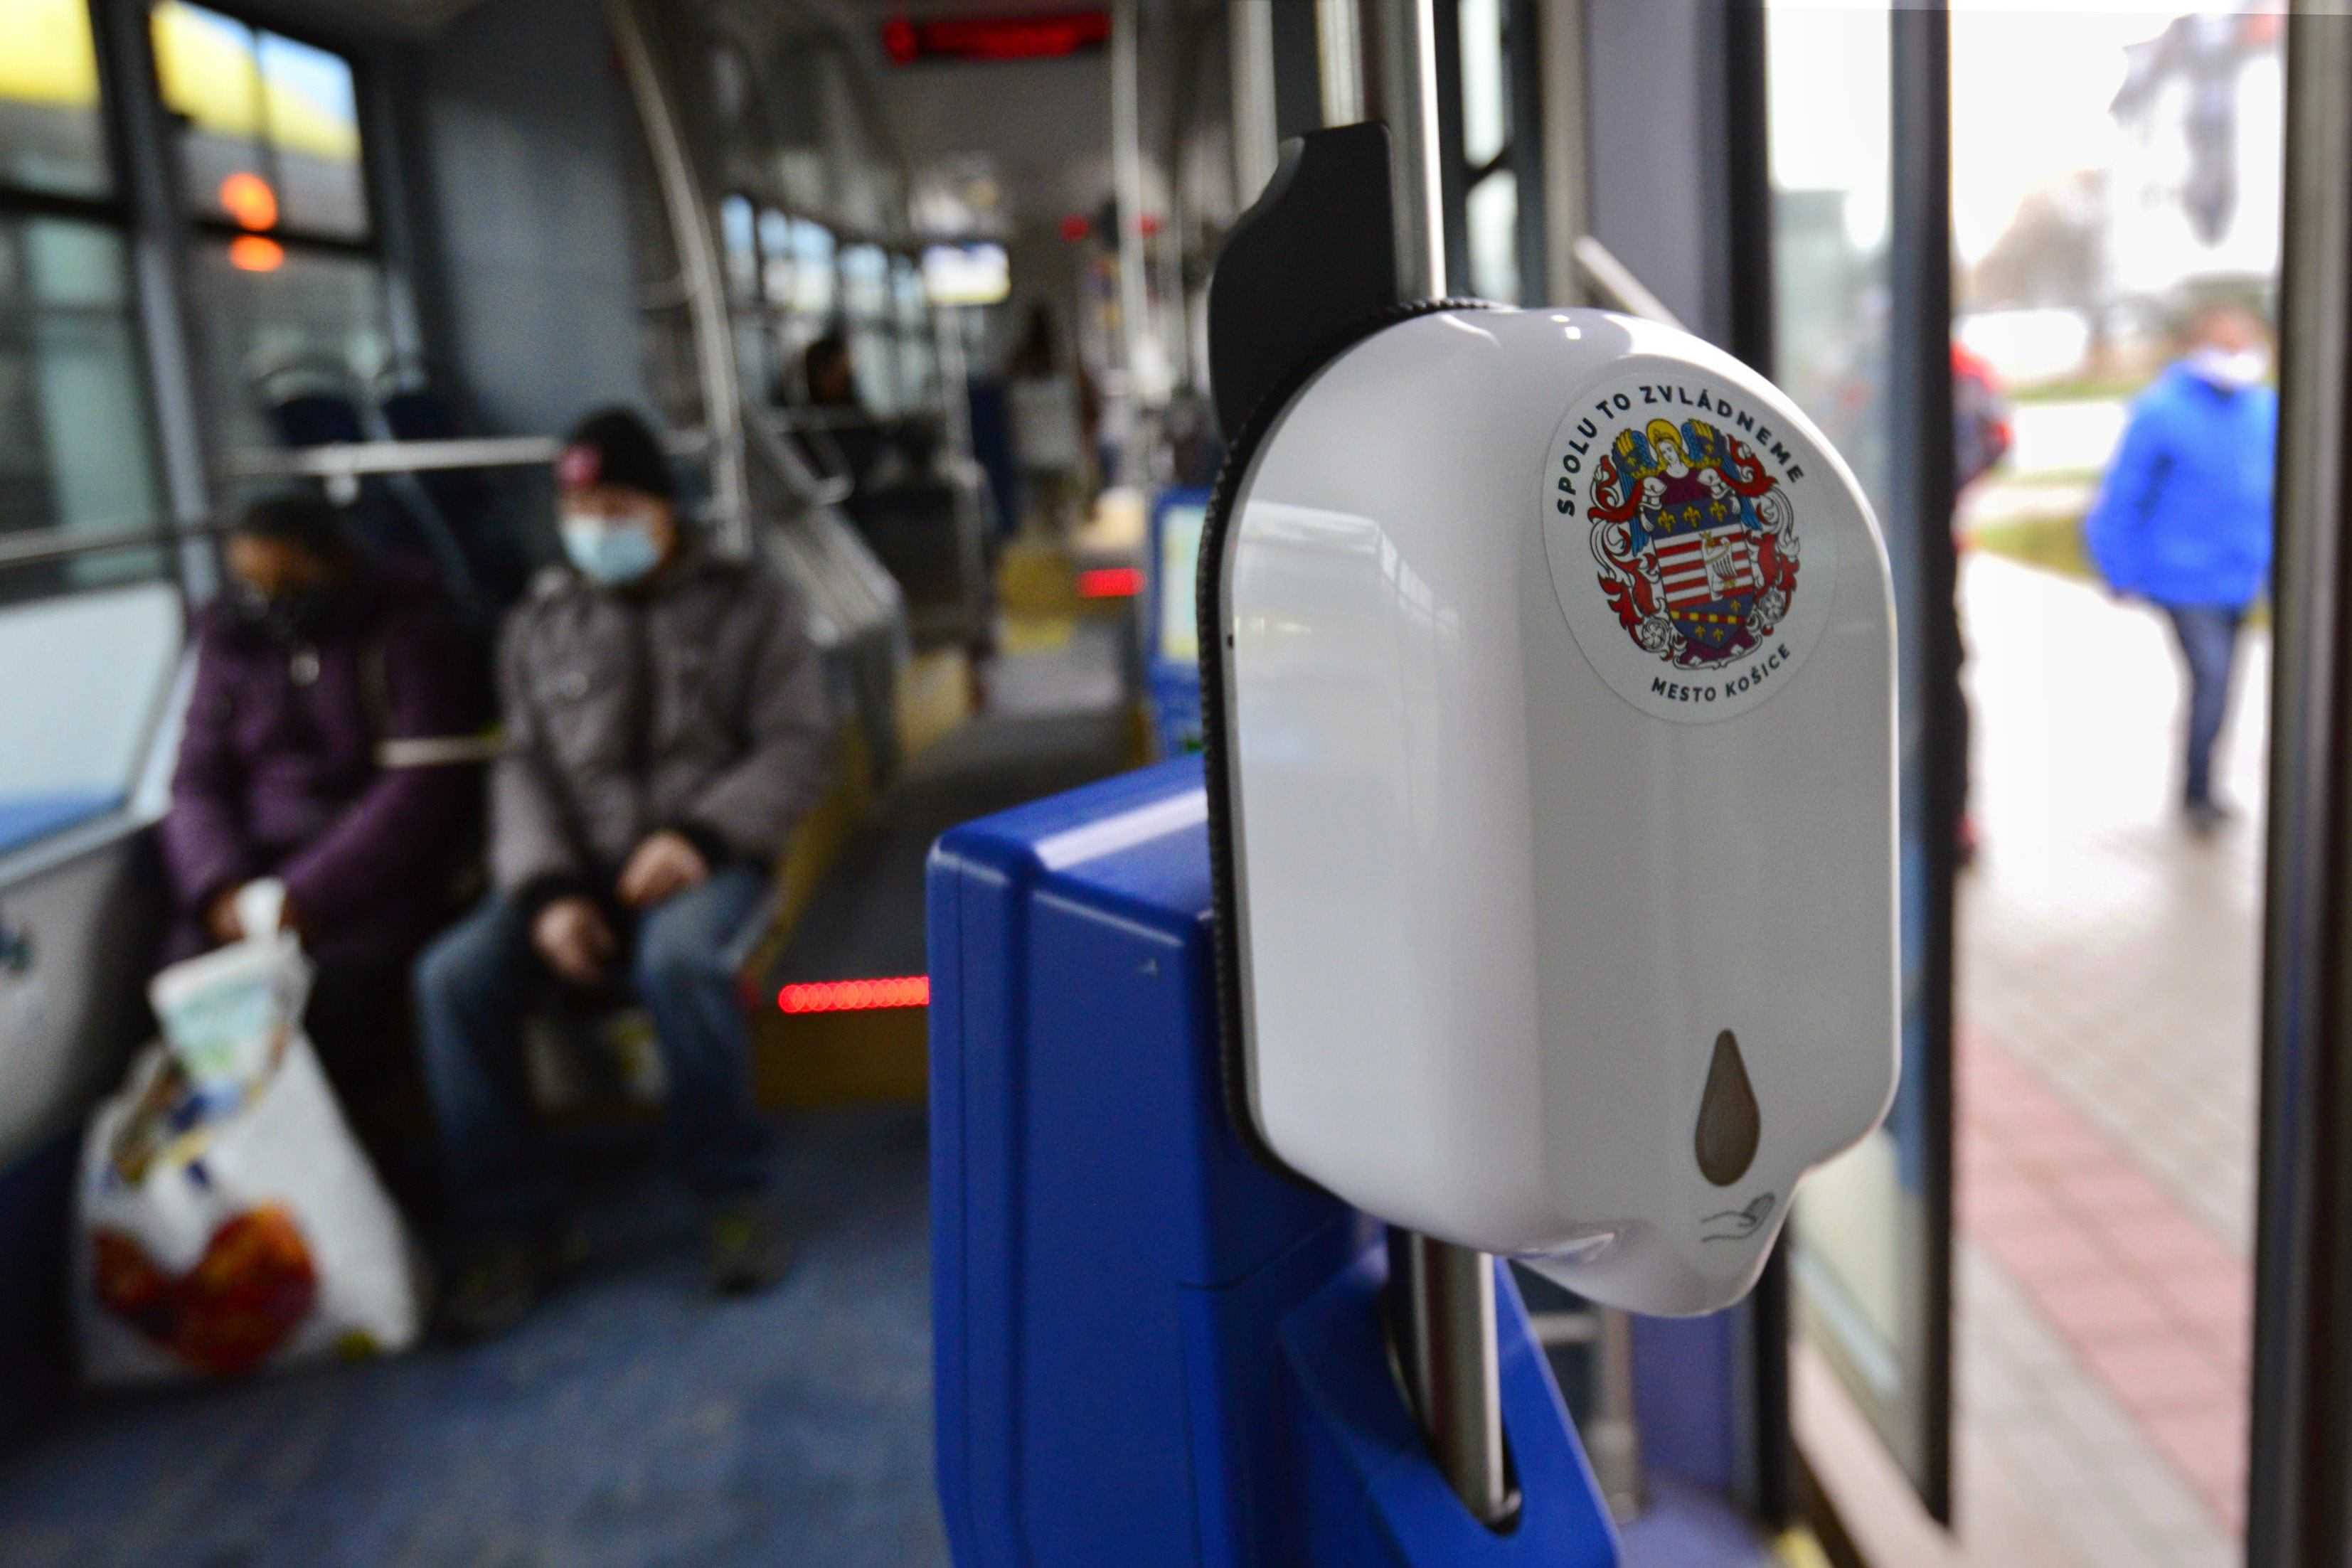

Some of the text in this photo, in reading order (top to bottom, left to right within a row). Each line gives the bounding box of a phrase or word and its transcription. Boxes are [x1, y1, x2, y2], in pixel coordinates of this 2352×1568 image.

[1557, 385, 1804, 517] SPOLU TO ZVLÁDNEME
[1651, 642, 1791, 703] MESTO KOŠICE
